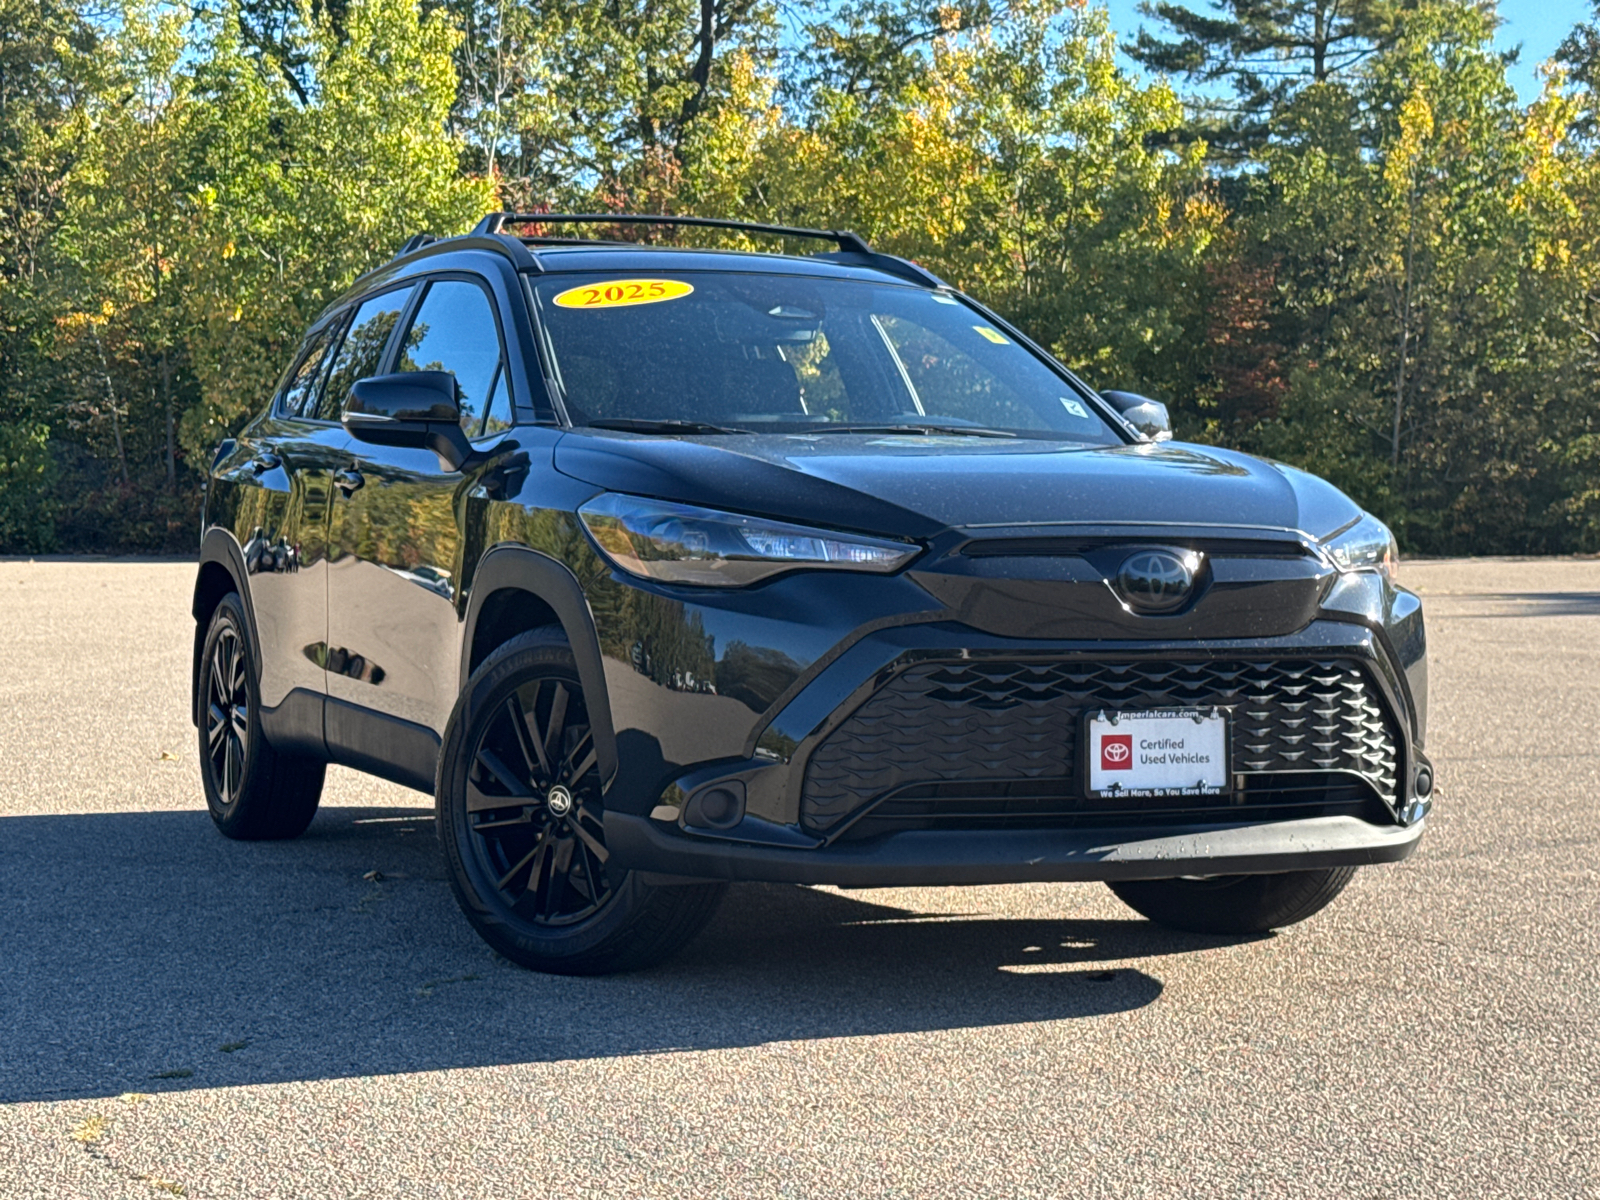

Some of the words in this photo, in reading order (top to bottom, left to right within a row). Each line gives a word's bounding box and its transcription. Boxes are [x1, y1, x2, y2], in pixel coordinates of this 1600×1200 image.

[583, 282, 665, 304] 2025
[1140, 738, 1184, 750] Certified
[1140, 753, 1166, 764] Used
[1168, 753, 1210, 764] Vehicles
[1100, 790, 1113, 798] We
[1114, 789, 1129, 798] Sell
[1131, 789, 1152, 798] More,
[1153, 788, 1163, 797] So
[1166, 788, 1180, 796] You
[1182, 787, 1199, 796] Save
[1201, 787, 1220, 795] More
